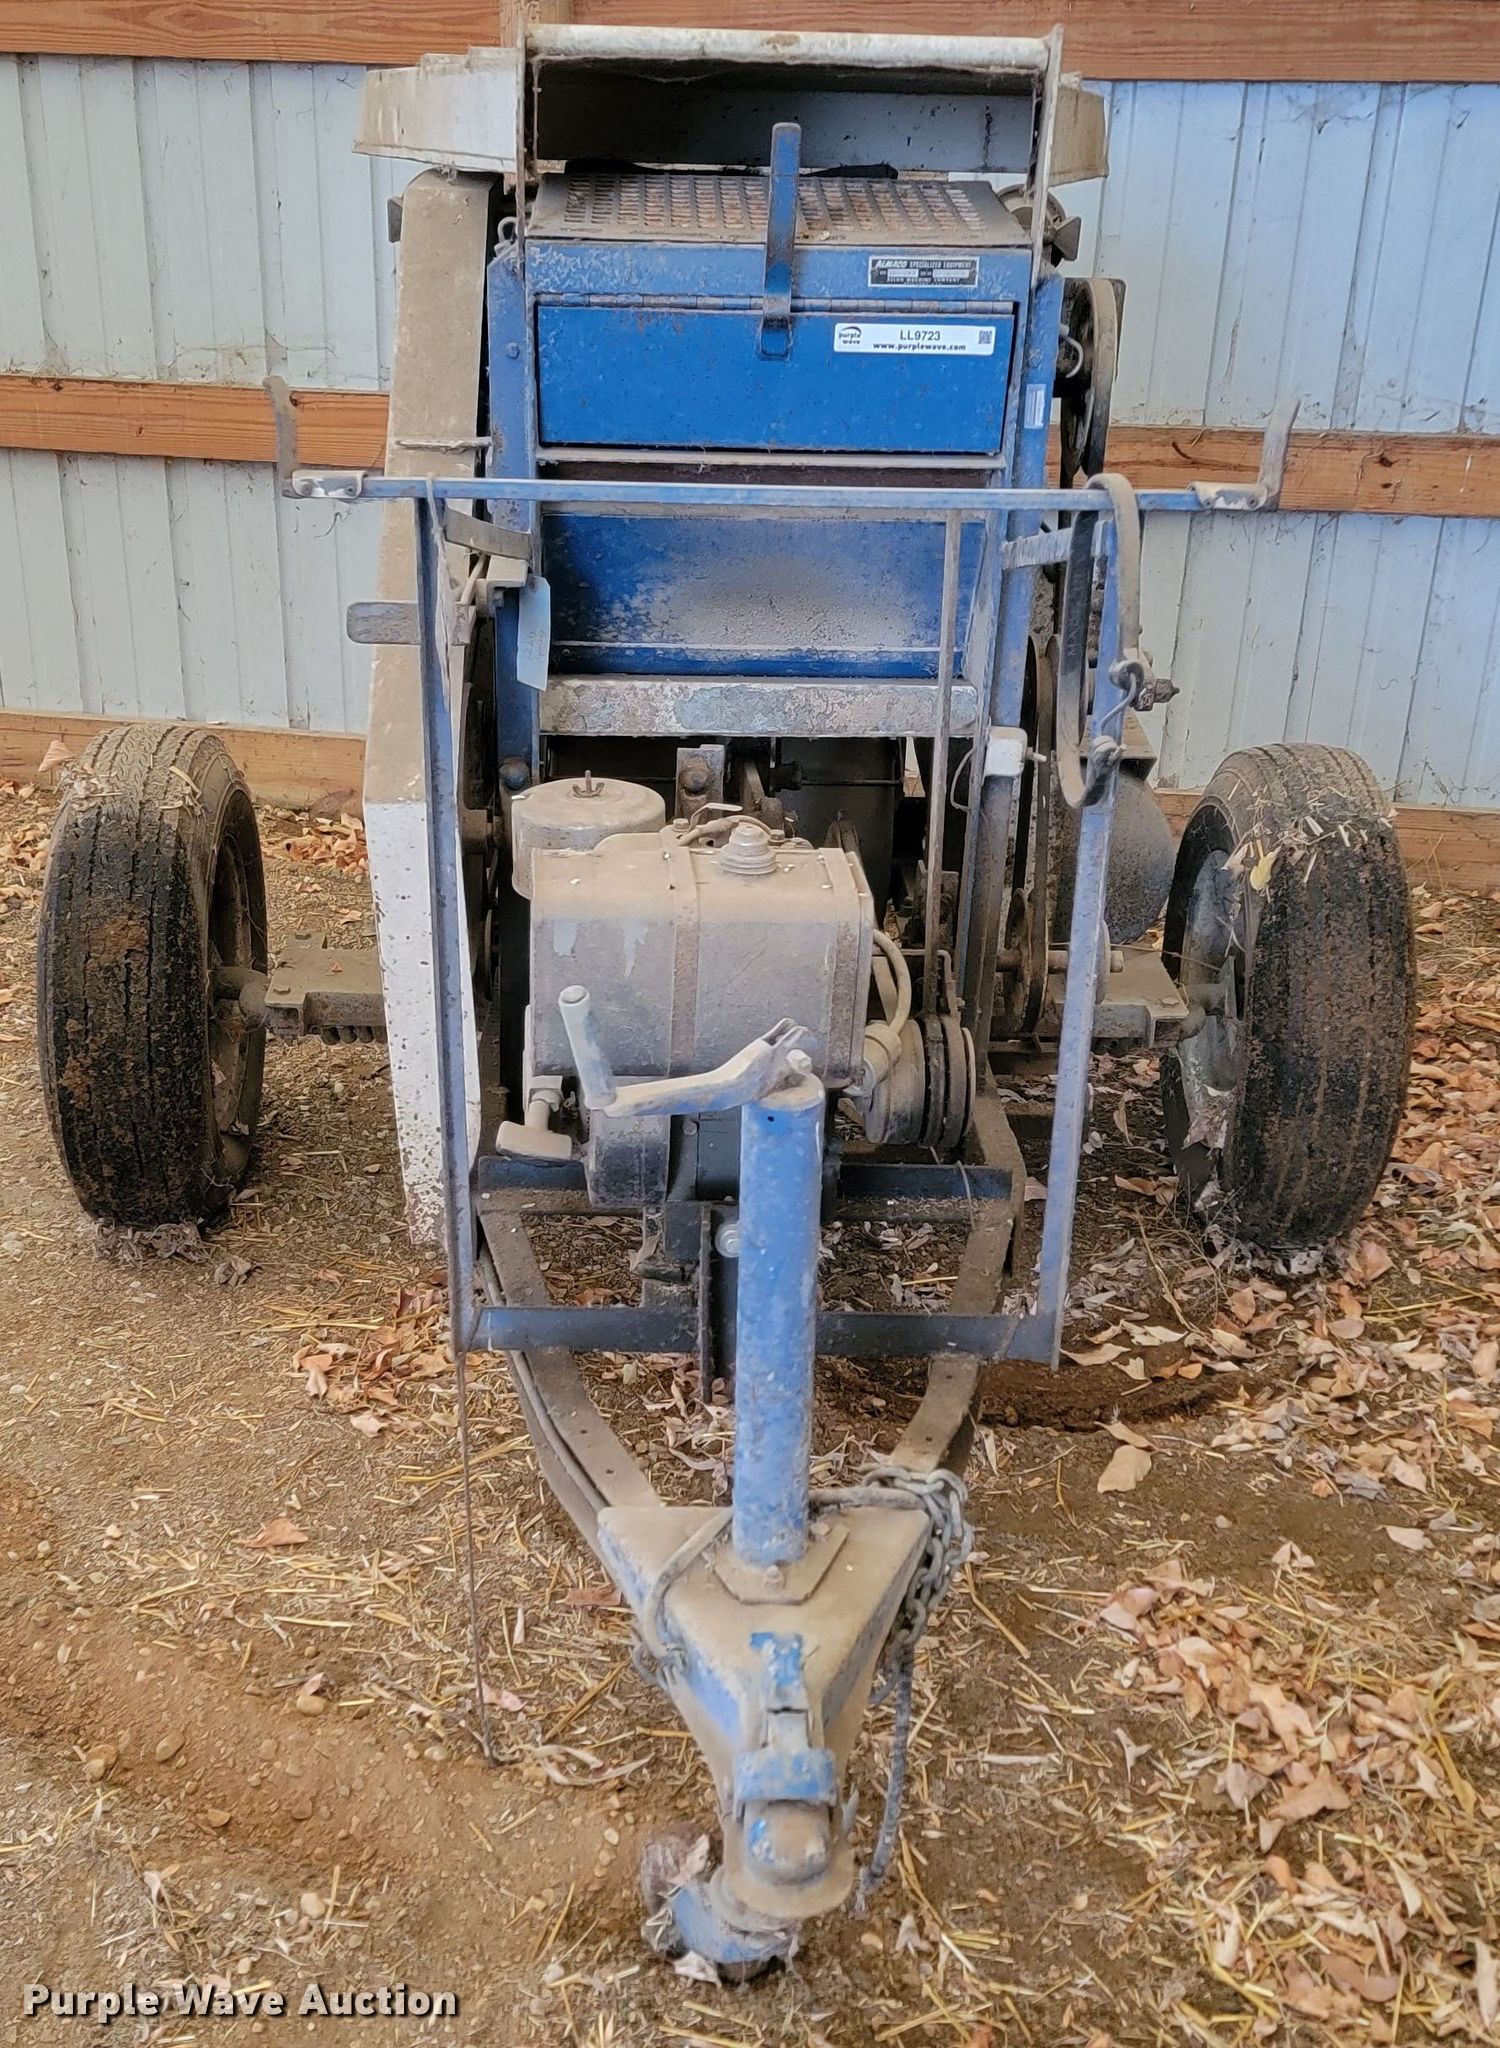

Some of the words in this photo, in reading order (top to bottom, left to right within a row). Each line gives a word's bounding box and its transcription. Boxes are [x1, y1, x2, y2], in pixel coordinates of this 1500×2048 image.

[875, 260, 908, 268] ALMACO
[909, 261, 942, 269] SPECIALIZED
[943, 262, 972, 270] EQUIPMENT
[900, 330, 941, 341] LL9723
[873, 342, 966, 351] www.purplewave.com
